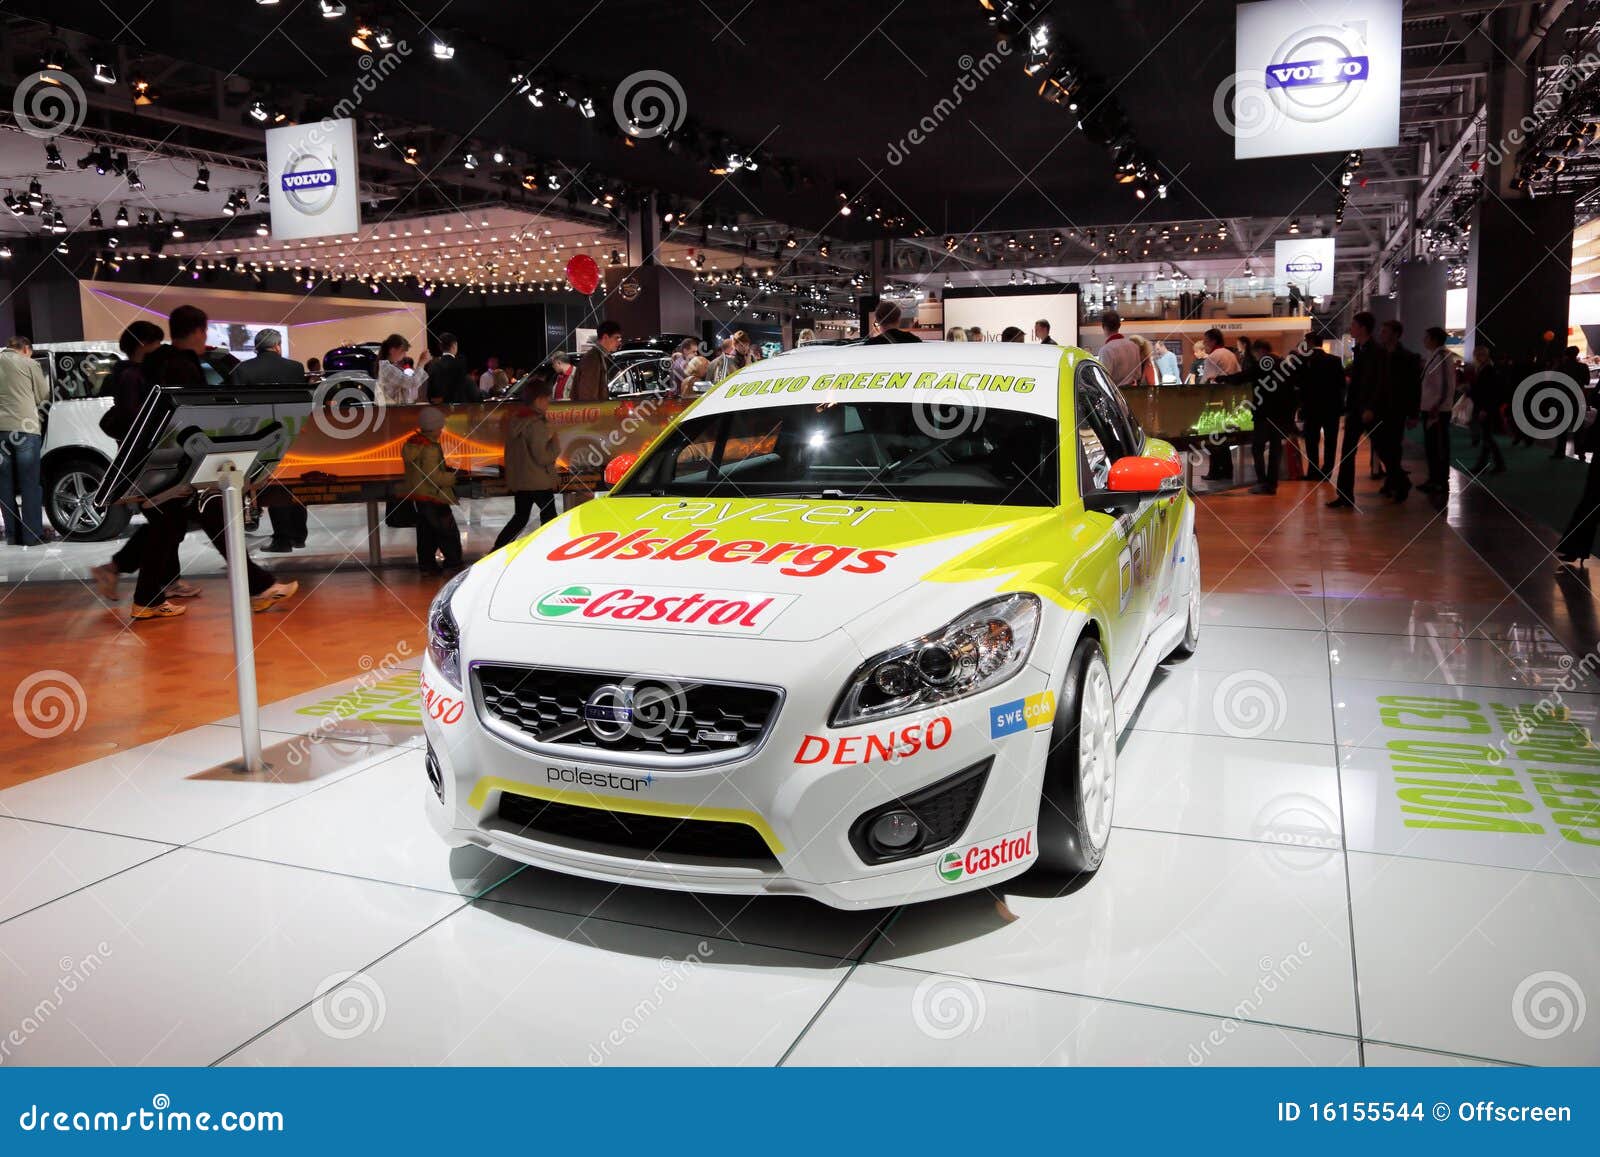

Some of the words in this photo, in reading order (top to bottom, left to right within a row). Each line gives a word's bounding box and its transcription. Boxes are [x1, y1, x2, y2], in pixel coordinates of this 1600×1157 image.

[284, 173, 331, 187] VOLVO
[724, 375, 810, 398] VOLVO
[811, 372, 912, 390] GREEN
[913, 372, 1036, 393] RACING
[635, 501, 897, 527] rayzer
[546, 529, 898, 577] Olsbergs
[583, 589, 775, 627] Castrol
[793, 716, 953, 765] DENSO
[546, 766, 648, 792] polestar
[965, 830, 1032, 875] Castrol
